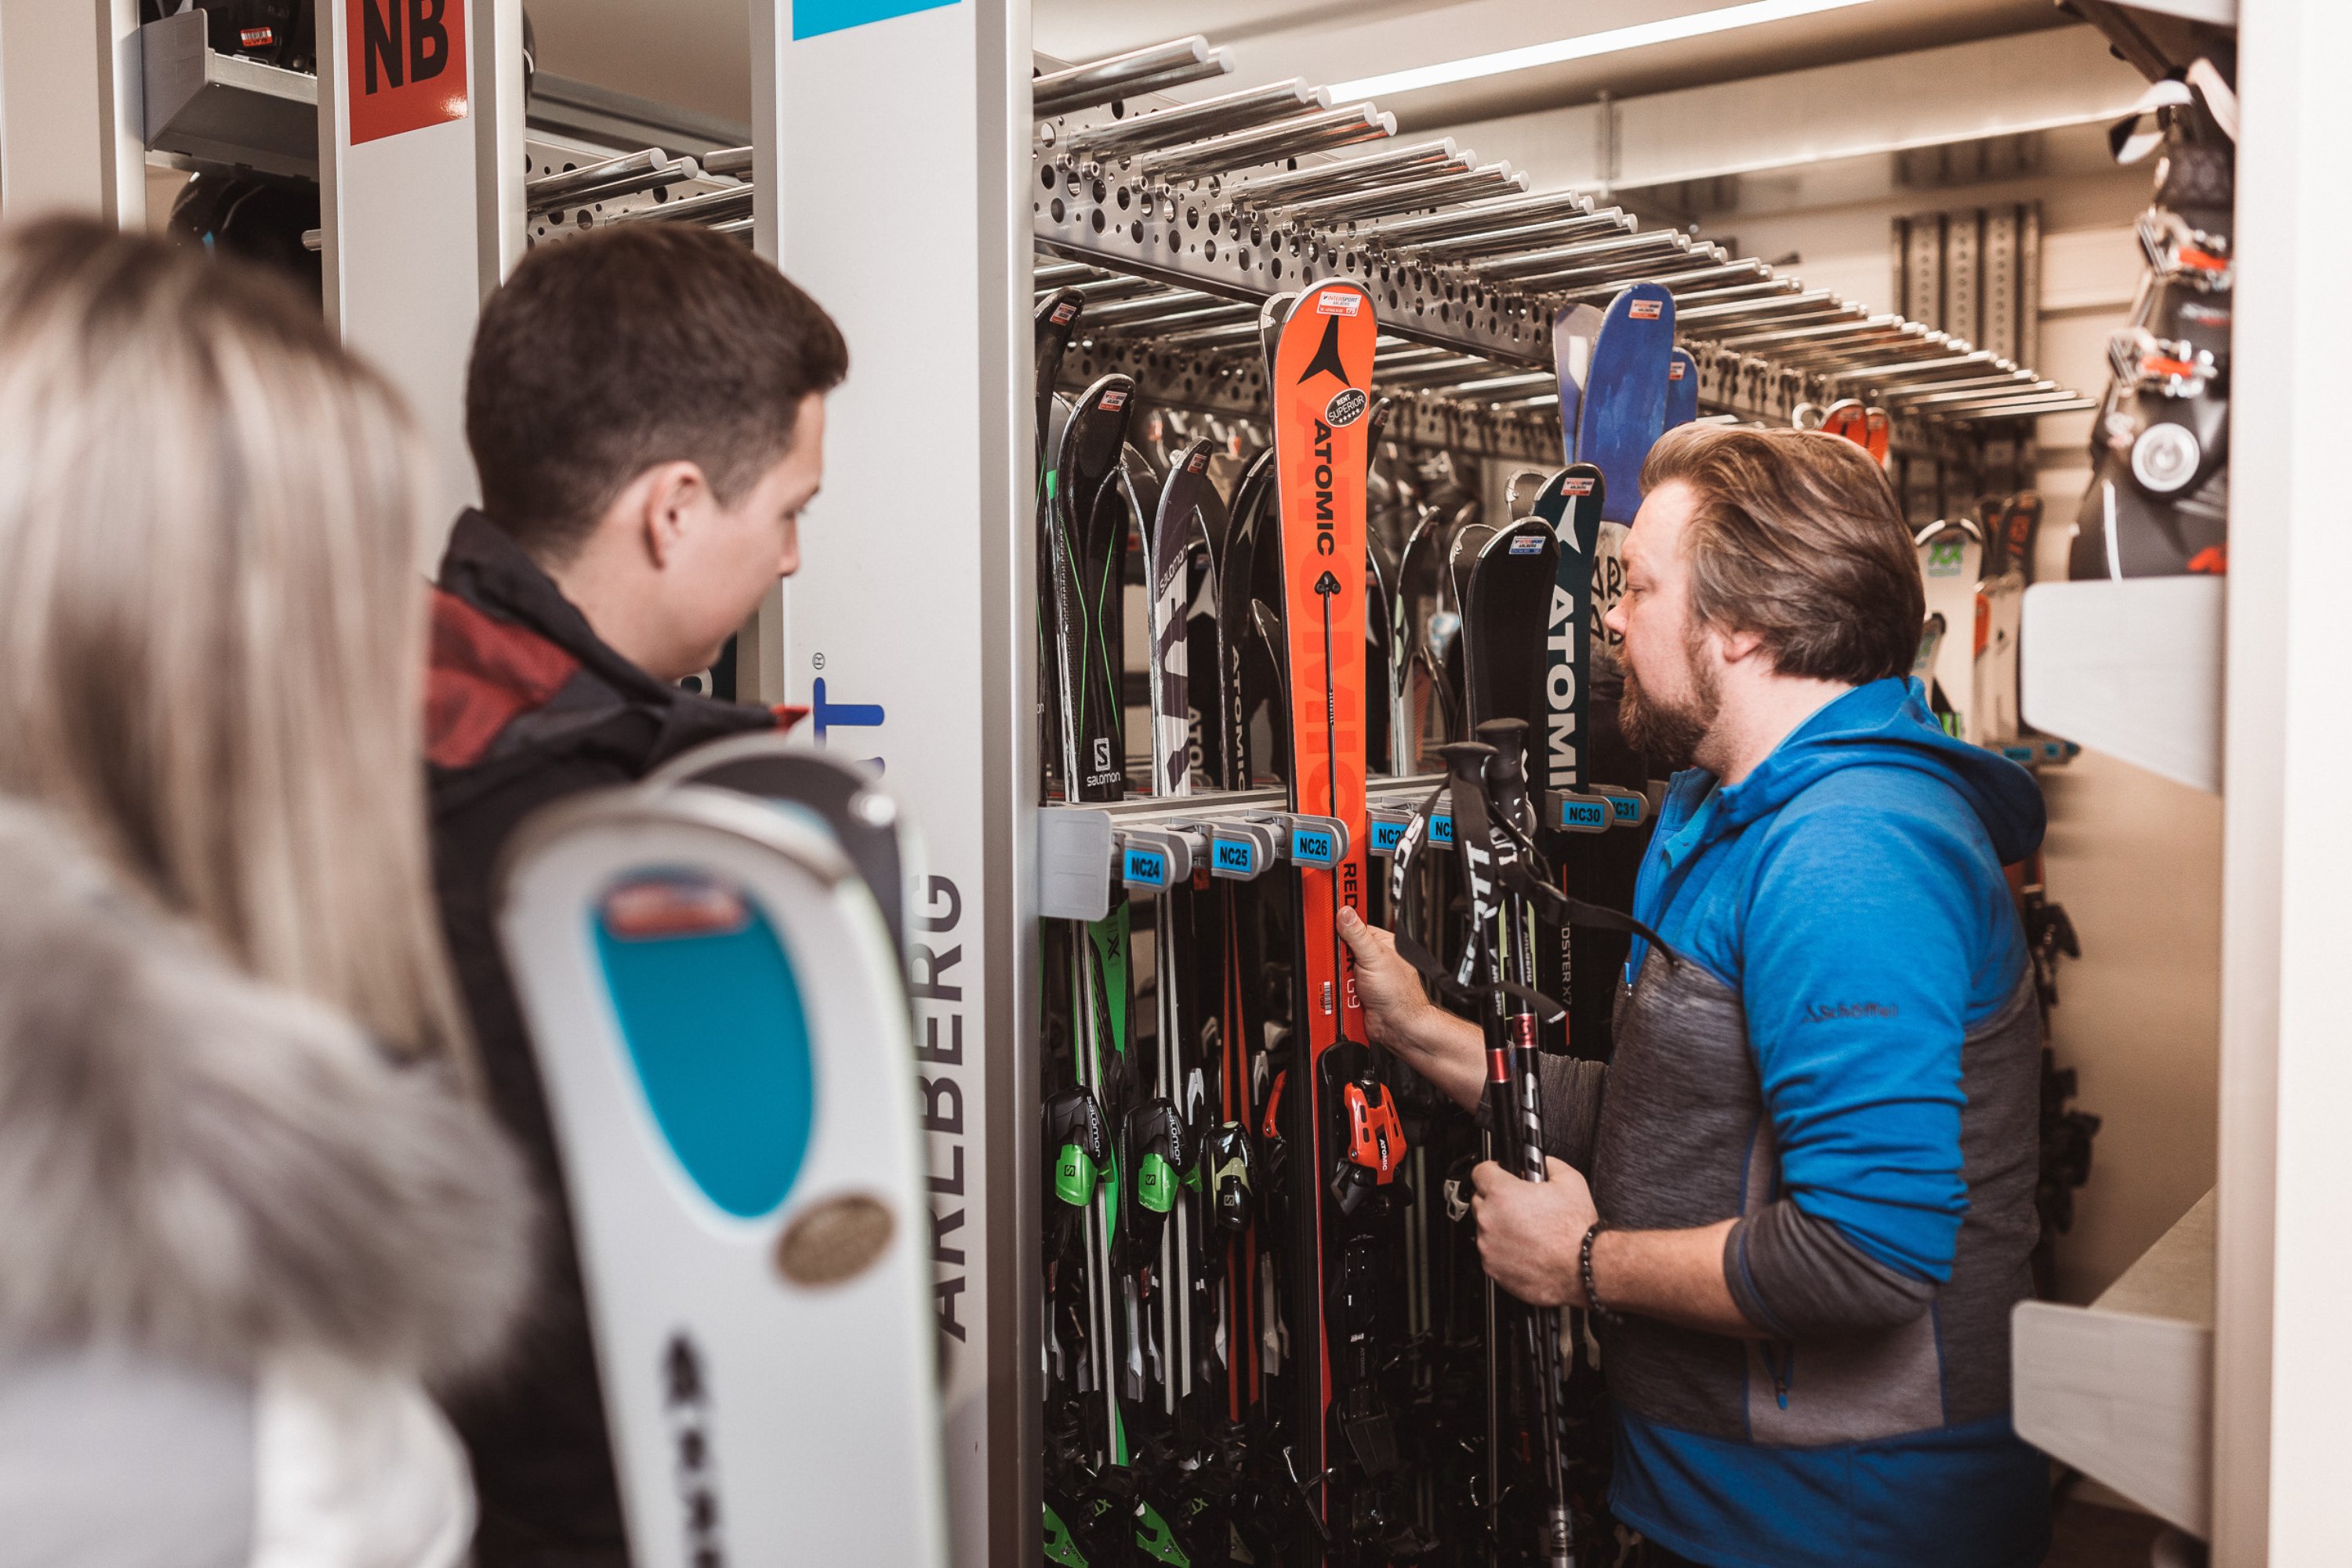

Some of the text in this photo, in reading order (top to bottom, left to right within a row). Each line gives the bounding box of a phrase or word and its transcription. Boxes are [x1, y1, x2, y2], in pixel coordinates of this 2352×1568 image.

[362, 0, 449, 95] NB
[1328, 395, 1364, 421] SUPERIOR
[1336, 394, 1351, 406] RENT
[1315, 418, 1334, 556] ATOMIC
[1547, 584, 1577, 787] ATOMI
[1087, 771, 1121, 786] salomon
[1569, 807, 1600, 822] NC30
[1299, 837, 1328, 857] NC26
[1378, 828, 1402, 844] NC2
[1131, 856, 1160, 878] NC24
[1219, 845, 1248, 867] NC25
[1561, 922, 1571, 982] DSTER
[1379, 1138, 1388, 1171] ATOMIC
